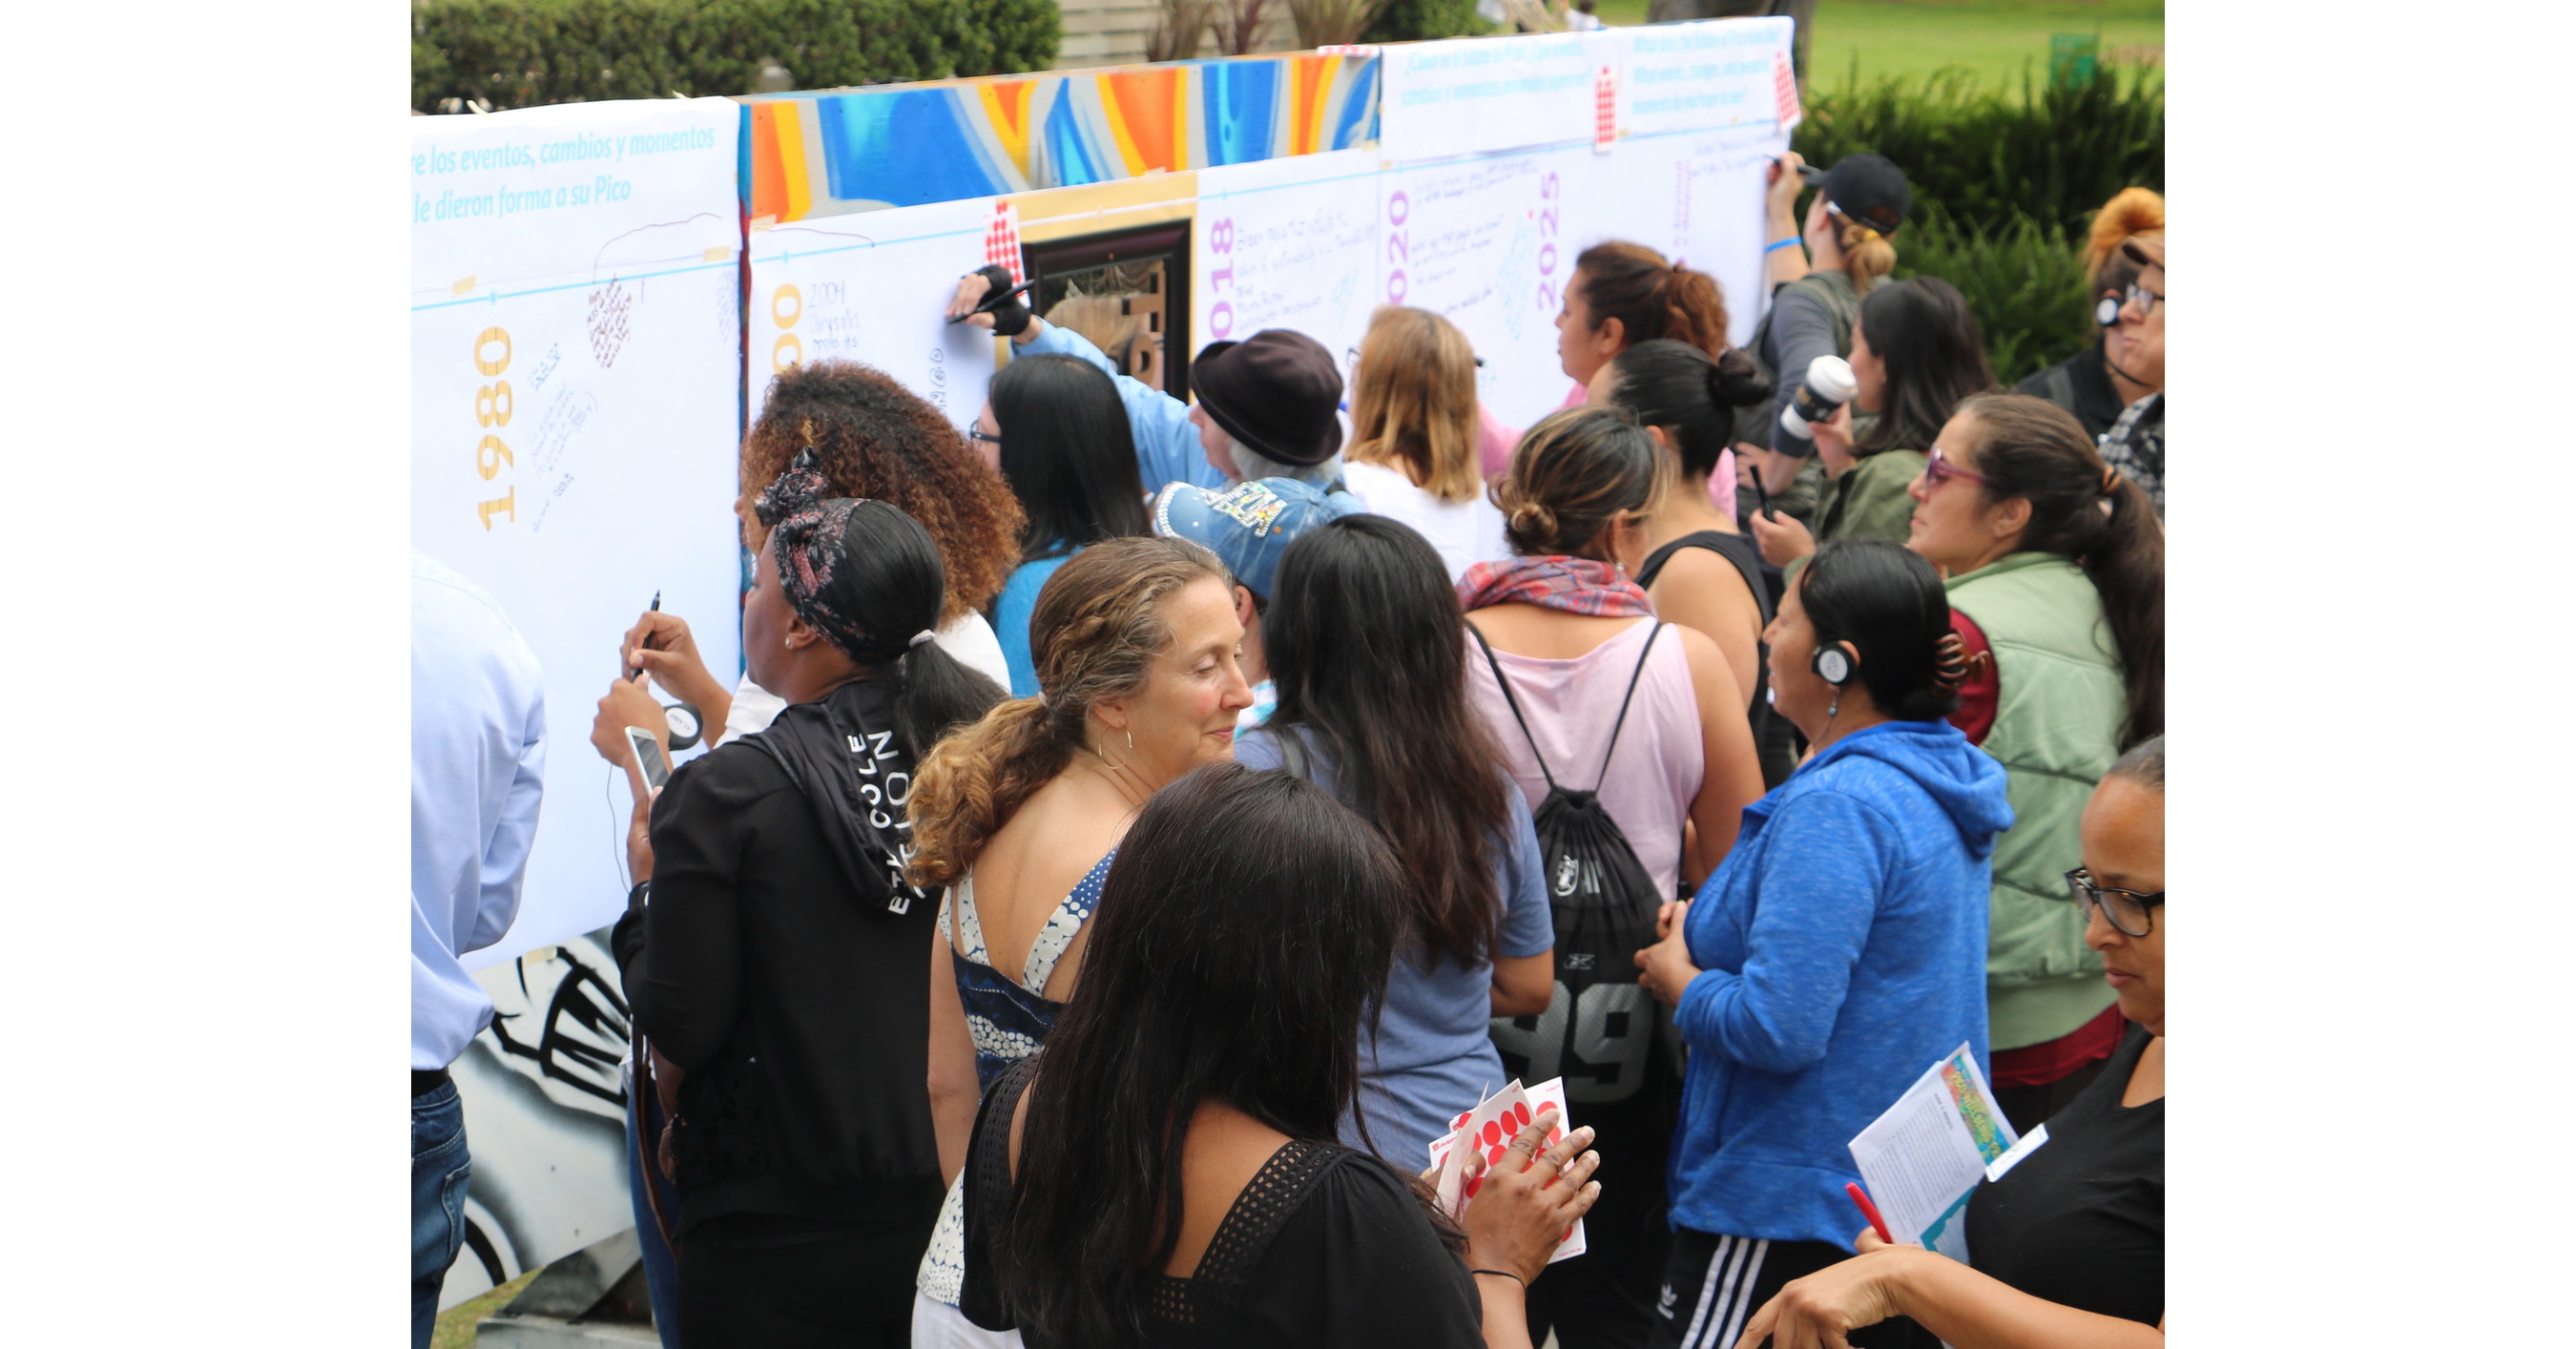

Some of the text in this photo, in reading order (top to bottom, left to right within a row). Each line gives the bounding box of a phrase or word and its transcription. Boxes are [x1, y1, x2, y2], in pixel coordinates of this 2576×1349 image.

[413, 175, 632, 222] le dieron forma a su Pico
[430, 144, 456, 175] los
[461, 142, 536, 173] eventos,
[540, 133, 612, 164] cambios
[614, 137, 625, 163] y
[630, 126, 715, 156] momentos
[1210, 217, 1234, 340] 018
[1387, 190, 1409, 305] 020
[1537, 170, 1559, 311] 2025
[473, 326, 515, 532] 1980
[847, 733, 891, 829] COLE
